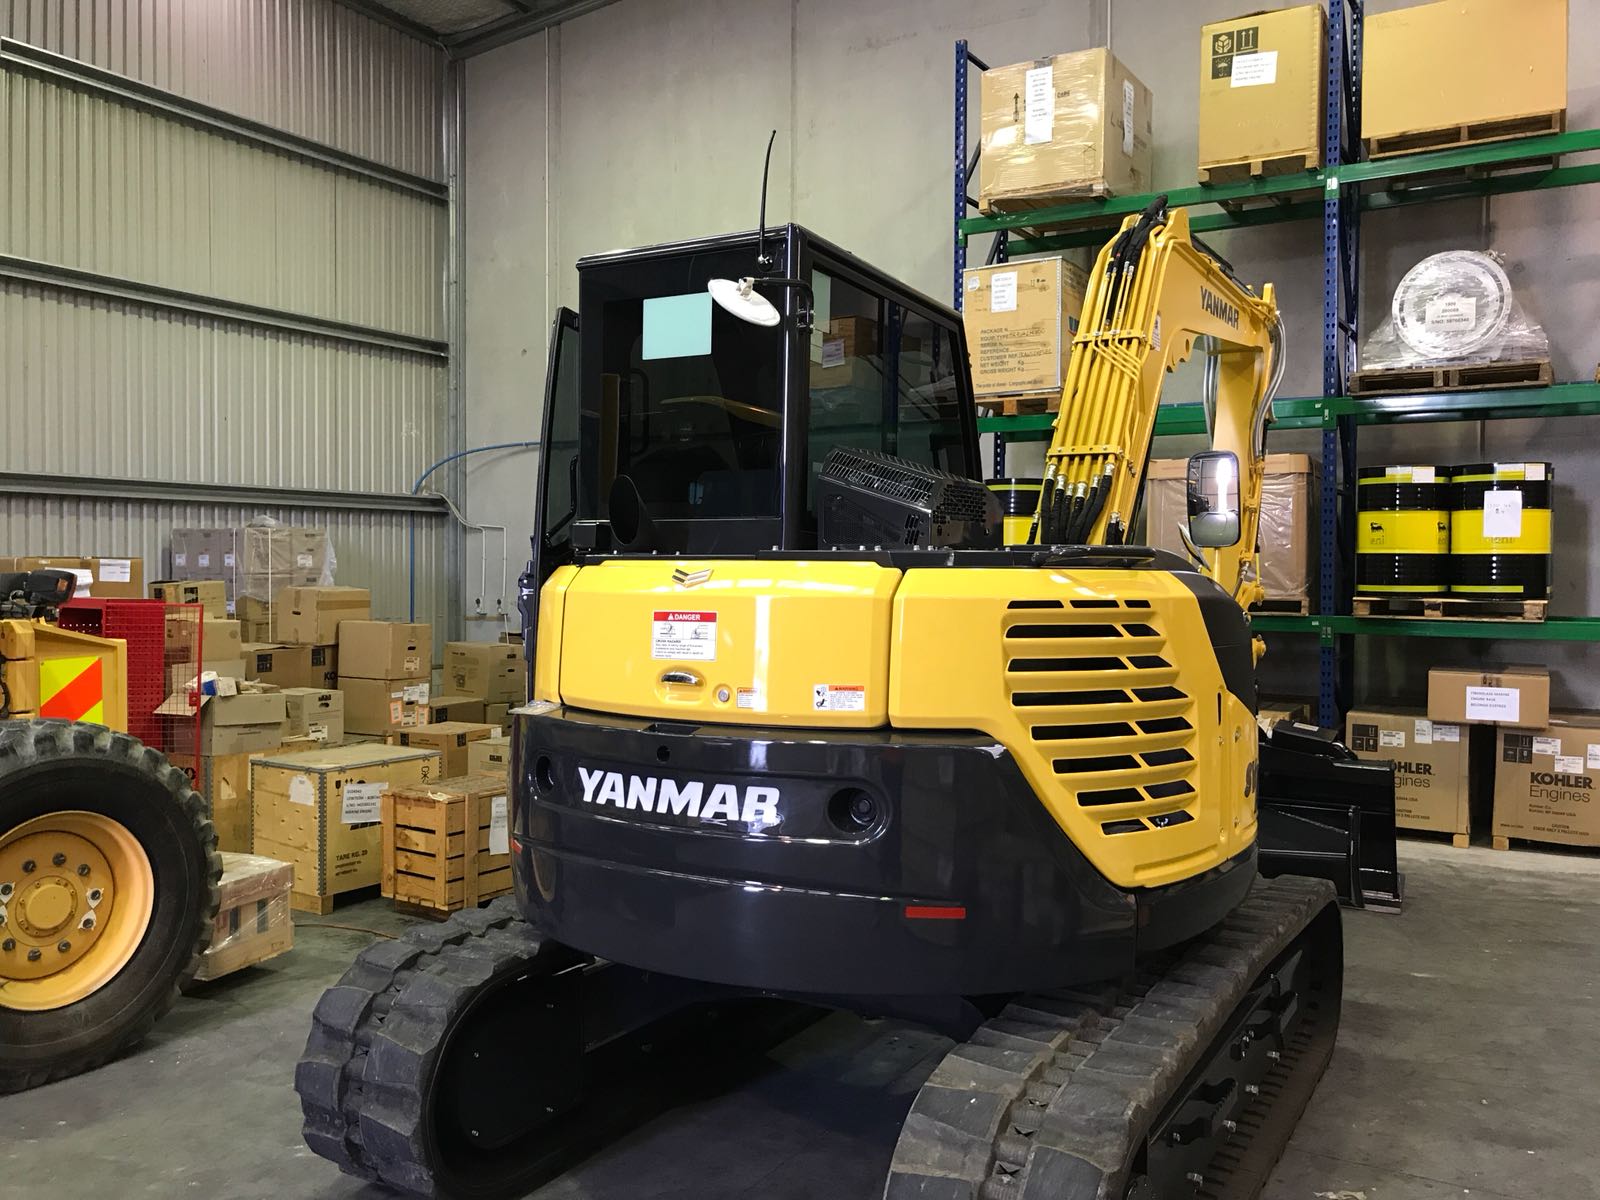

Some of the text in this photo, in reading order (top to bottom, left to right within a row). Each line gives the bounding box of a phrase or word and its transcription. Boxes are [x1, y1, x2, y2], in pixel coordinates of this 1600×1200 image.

[1200, 285, 1239, 330] YANMAR
[1370, 535, 1385, 544] eni
[674, 613, 701, 621] DANGER
[324, 671, 337, 680] KO
[1530, 772, 1593, 789] KOHLER
[577, 767, 781, 823] YANMAR
[1529, 784, 1591, 803] Engines
[336, 851, 351, 861] TARE
